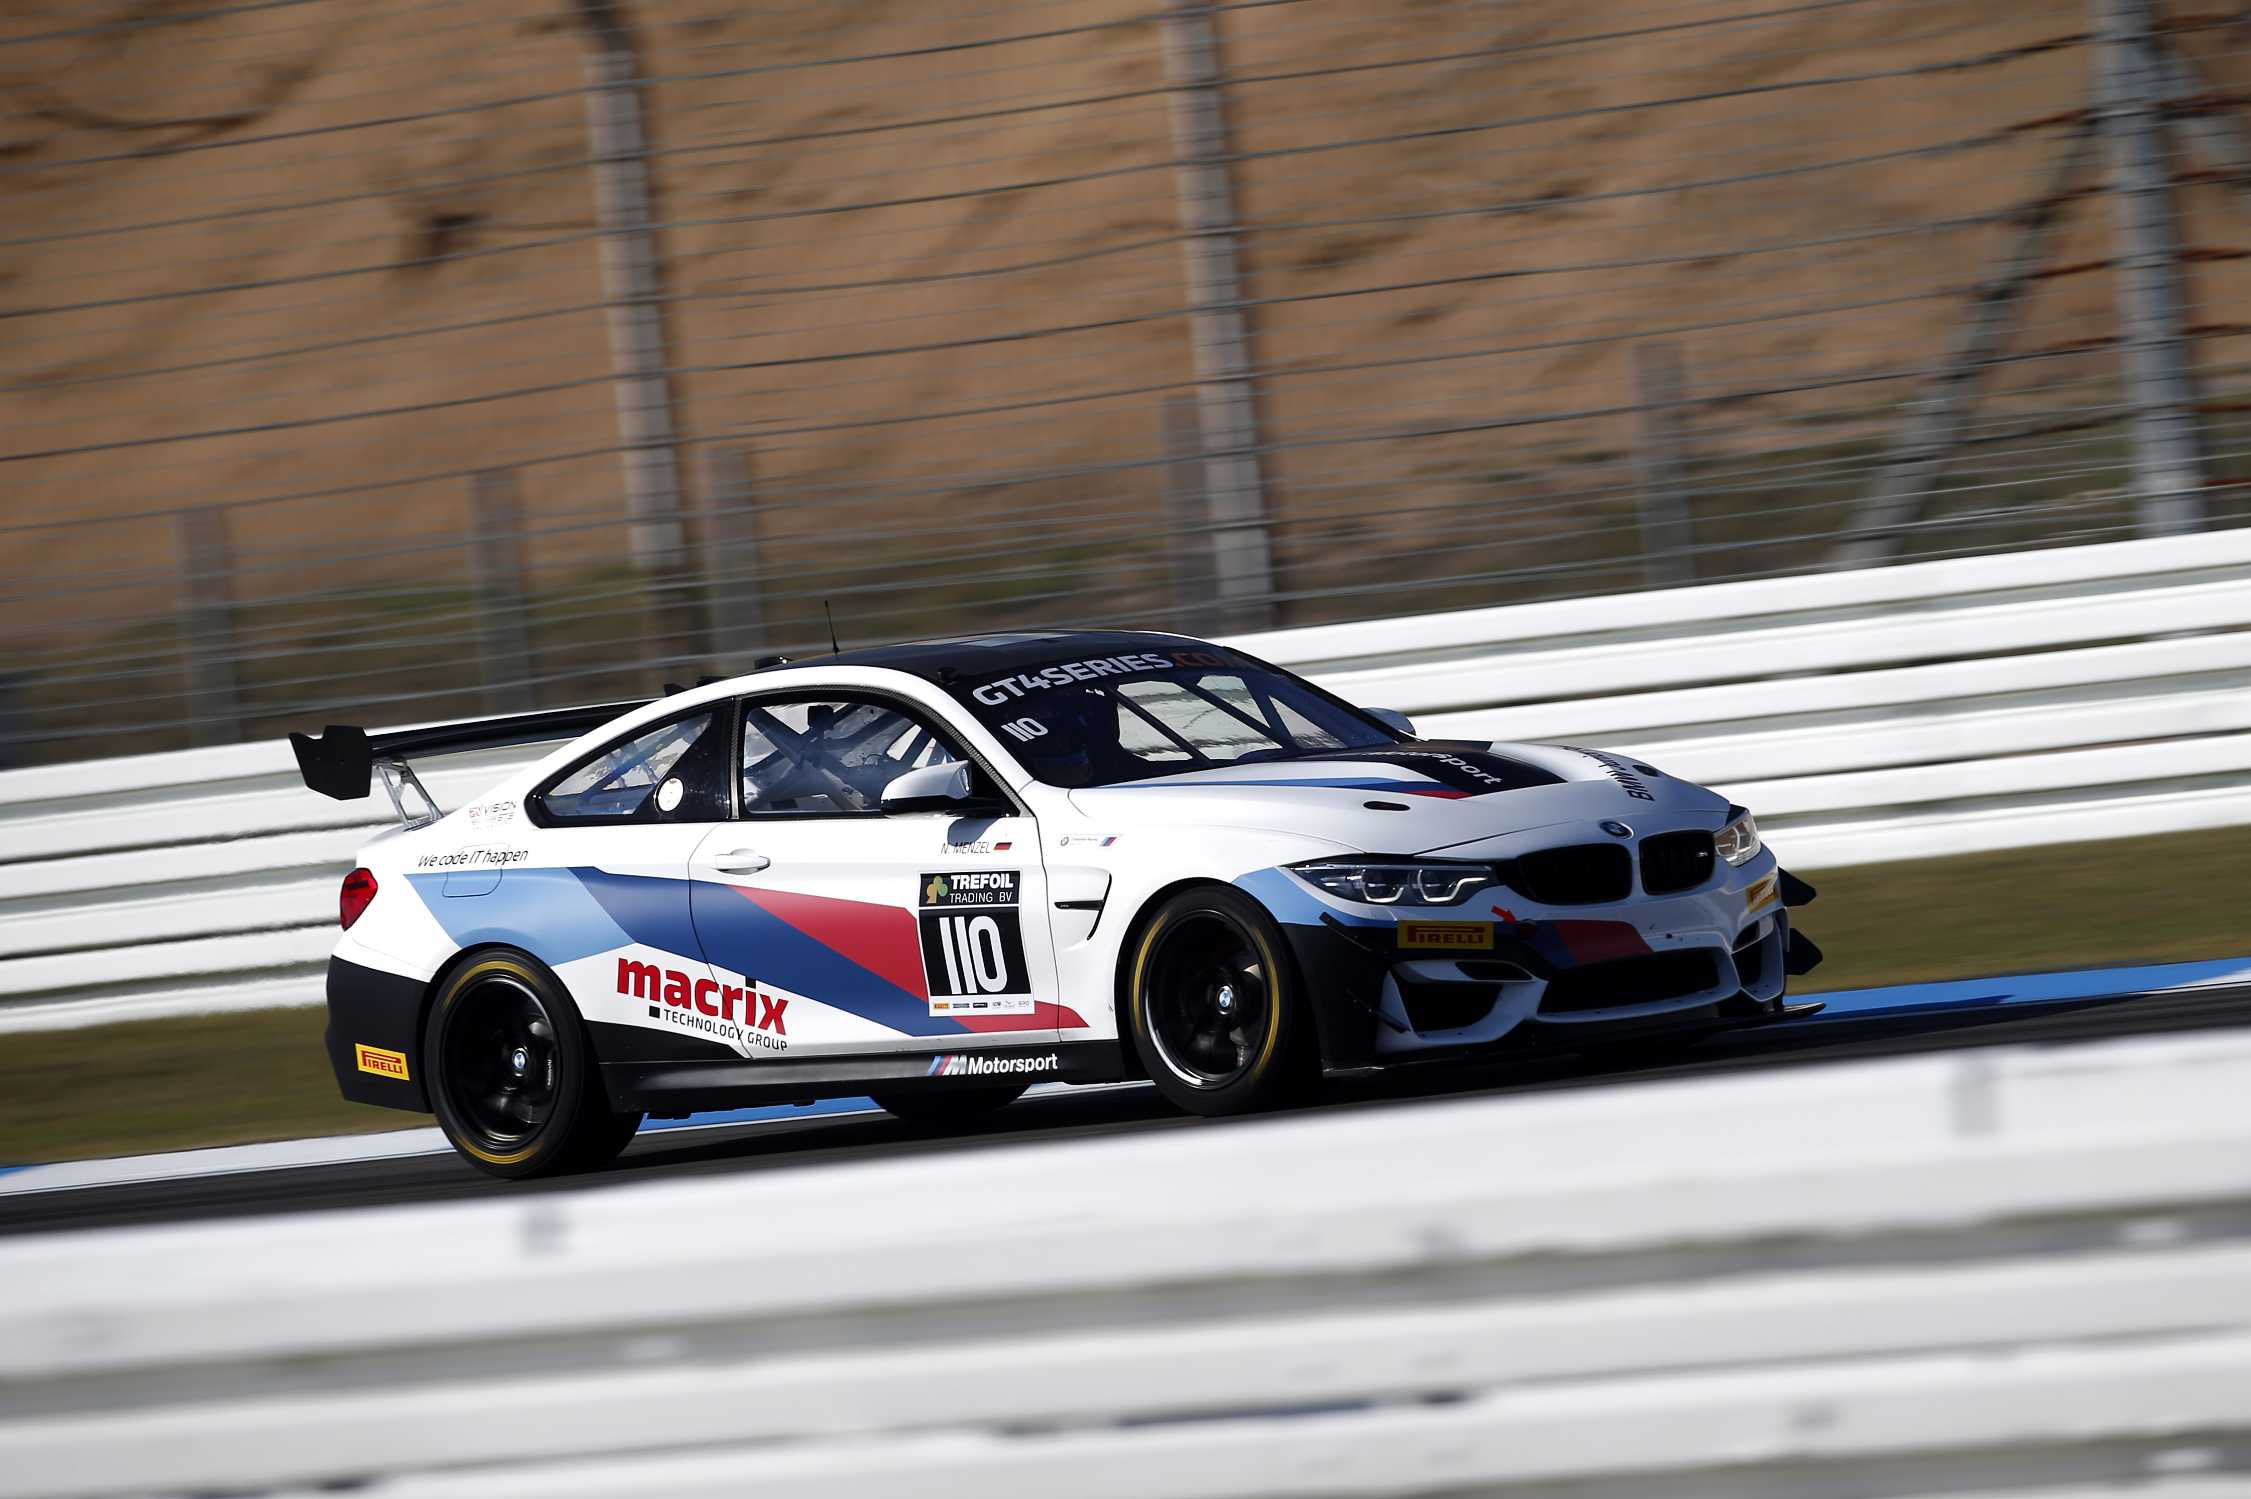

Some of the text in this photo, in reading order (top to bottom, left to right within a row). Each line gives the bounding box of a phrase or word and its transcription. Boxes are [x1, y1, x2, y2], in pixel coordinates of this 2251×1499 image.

[1001, 717, 1049, 742] 110
[418, 849, 529, 867] We code IT happen
[953, 841, 990, 854] MENZEL
[950, 873, 1014, 890] TREFOIL
[950, 891, 1013, 904] TRADING BV
[1407, 925, 1485, 944] PIRELLI
[938, 915, 1009, 995] 110
[617, 957, 789, 1036] macrix
[664, 1008, 788, 1051] TECHNOLOGY GROUP
[361, 1050, 403, 1074] PIRELLI
[968, 1053, 1059, 1075] Motorsport
